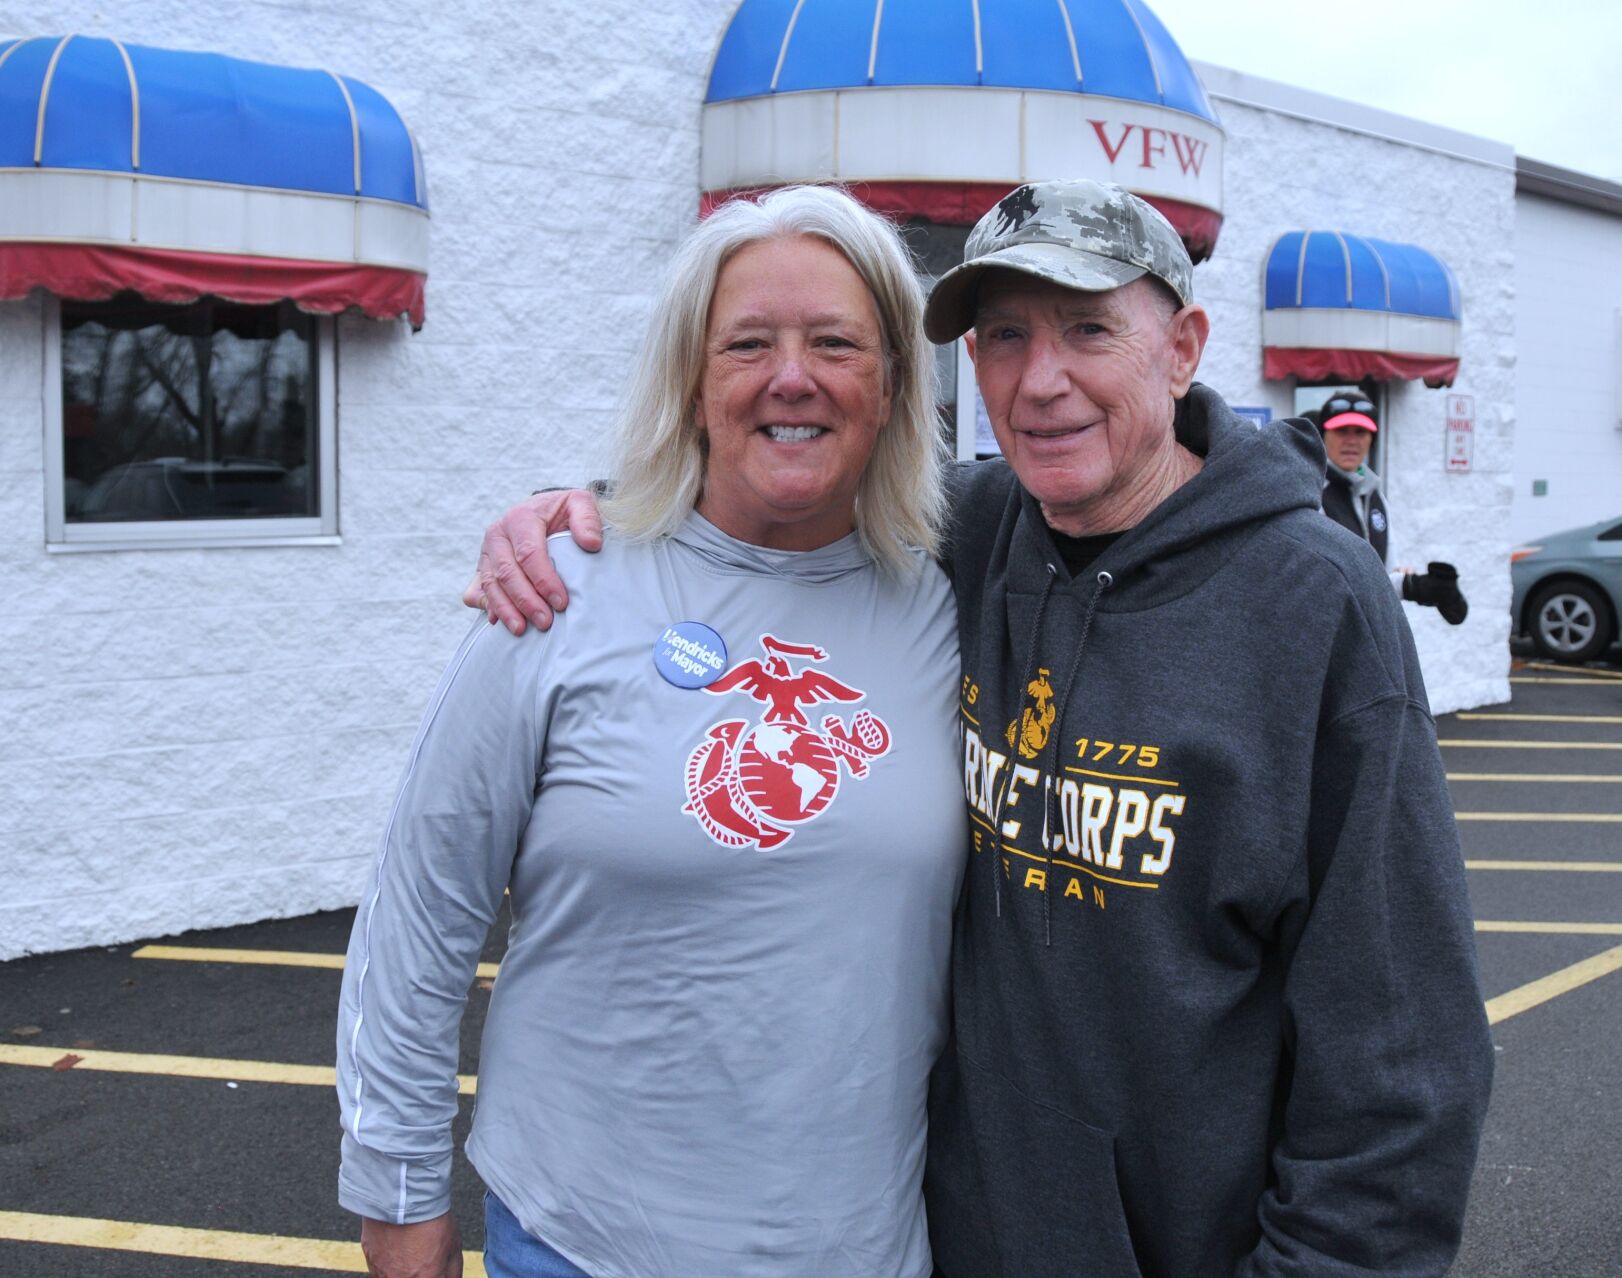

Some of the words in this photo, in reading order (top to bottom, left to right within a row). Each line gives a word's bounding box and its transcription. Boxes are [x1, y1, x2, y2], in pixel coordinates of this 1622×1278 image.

[1086, 118, 1208, 178] VFW
[662, 628, 724, 670] Hendricks
[670, 650, 709, 678] Mayor
[1075, 738, 1160, 768] 1775
[1042, 774, 1187, 876] CORPS
